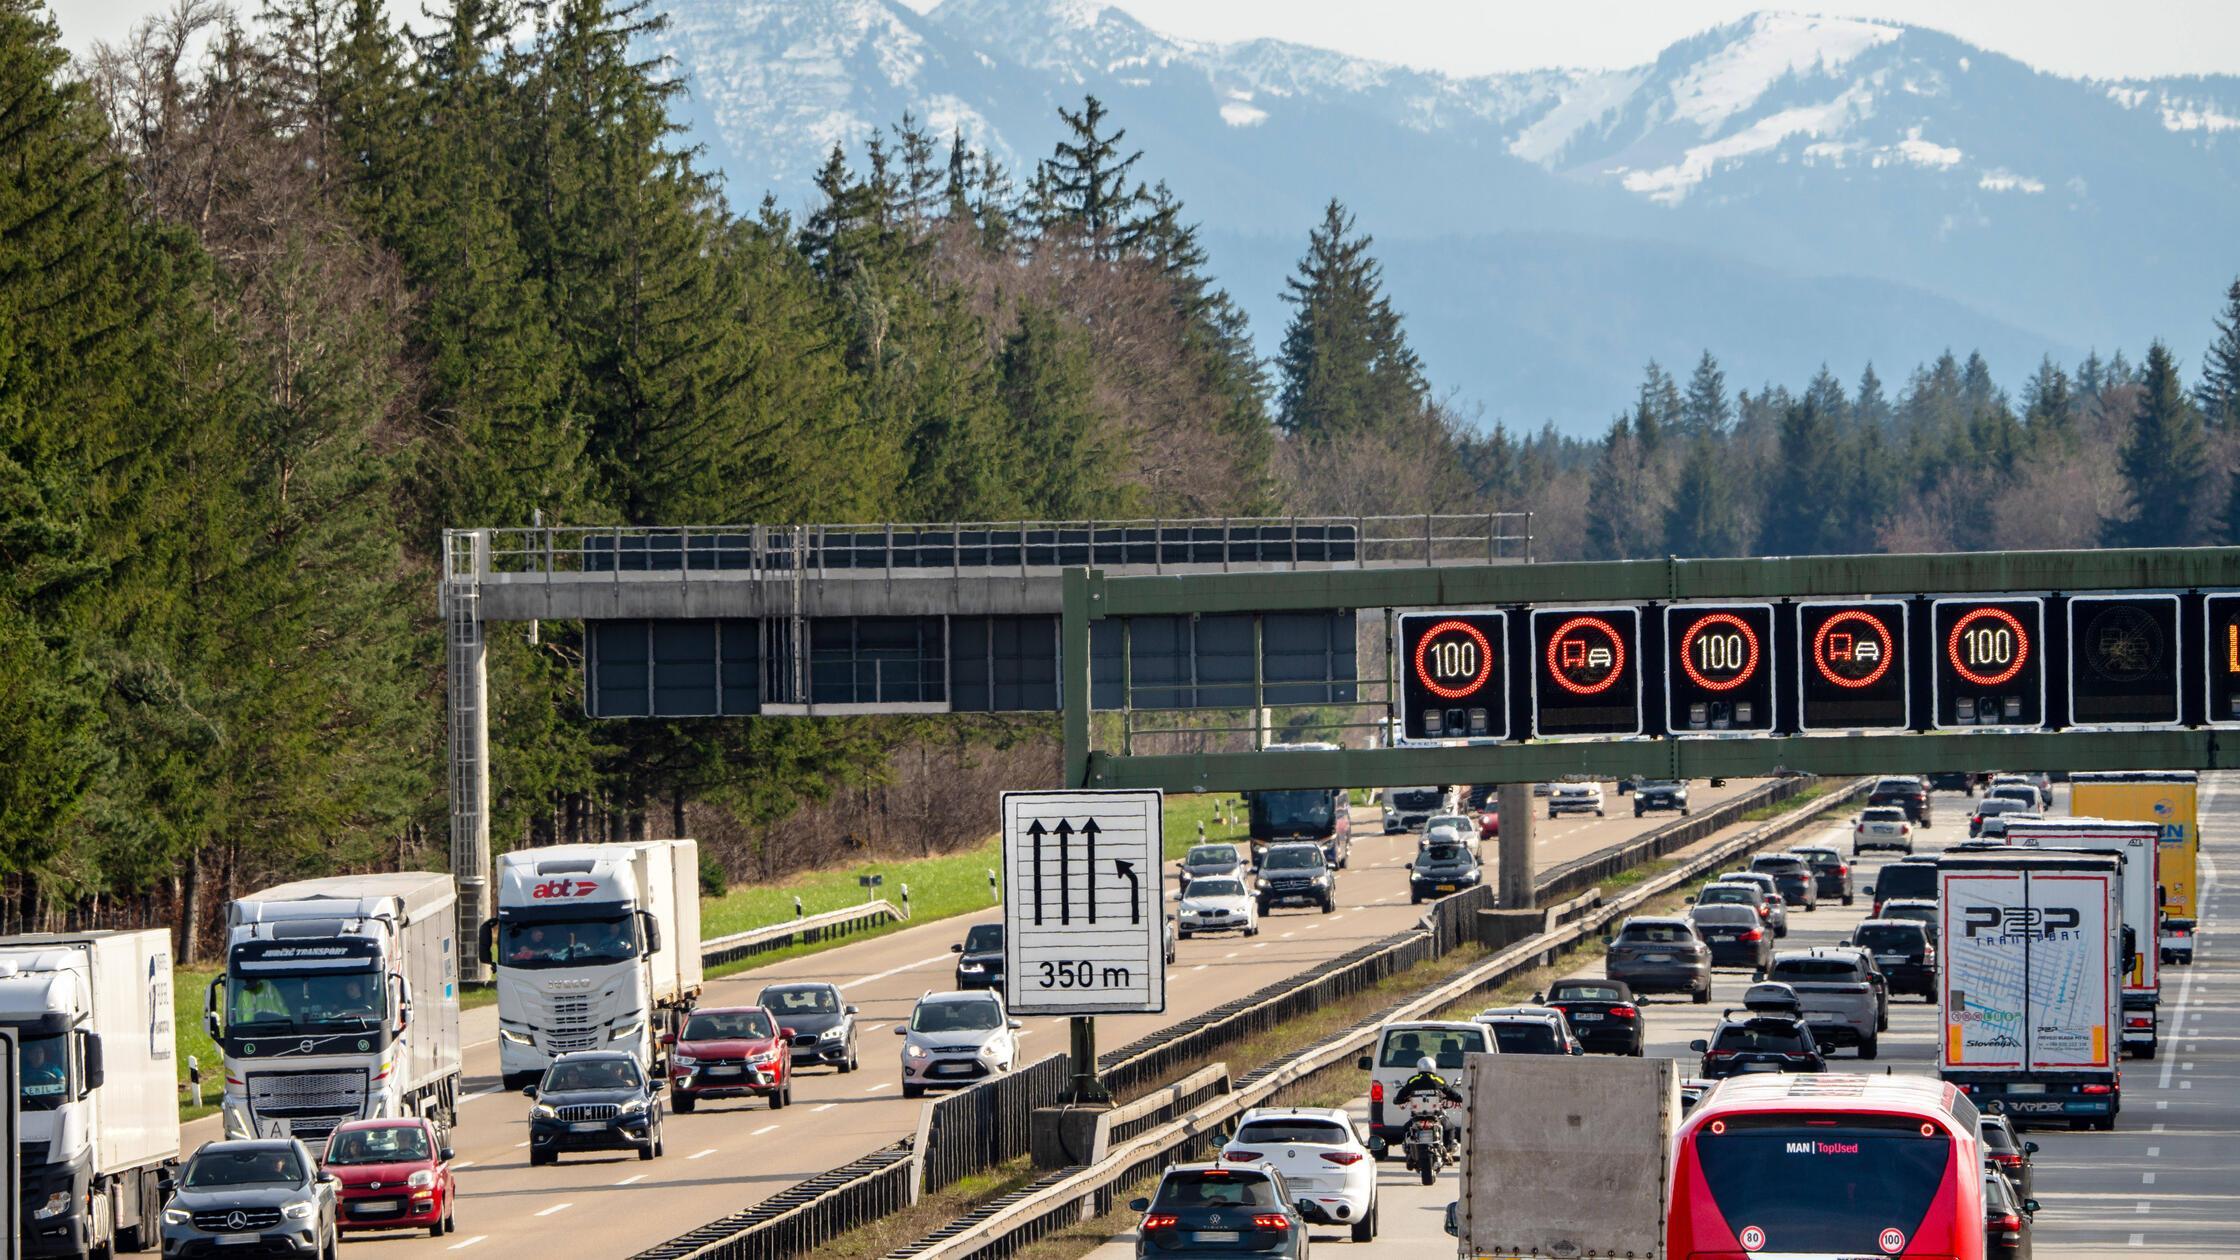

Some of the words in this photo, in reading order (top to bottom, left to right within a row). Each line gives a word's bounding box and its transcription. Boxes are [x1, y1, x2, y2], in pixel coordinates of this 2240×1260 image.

[1697, 634, 1742, 670] 100
[1965, 628, 2010, 664] 100
[1431, 642, 1475, 678] 100
[533, 879, 573, 899] abt
[1965, 907, 2080, 938] P2P
[296, 947, 349, 956] TRANSPORT
[1039, 960, 1093, 988] 350
[1103, 968, 1129, 987] m
[1967, 1040, 2017, 1049] Slovenija
[2008, 1102, 2063, 1112] RAPIDEX
[270, 1121, 283, 1138] A
[1786, 1142, 1810, 1153] MAN
[1817, 1142, 1859, 1156] TopUsed
[1746, 1232, 1759, 1243] 80
[1884, 1234, 1900, 1245] 100
